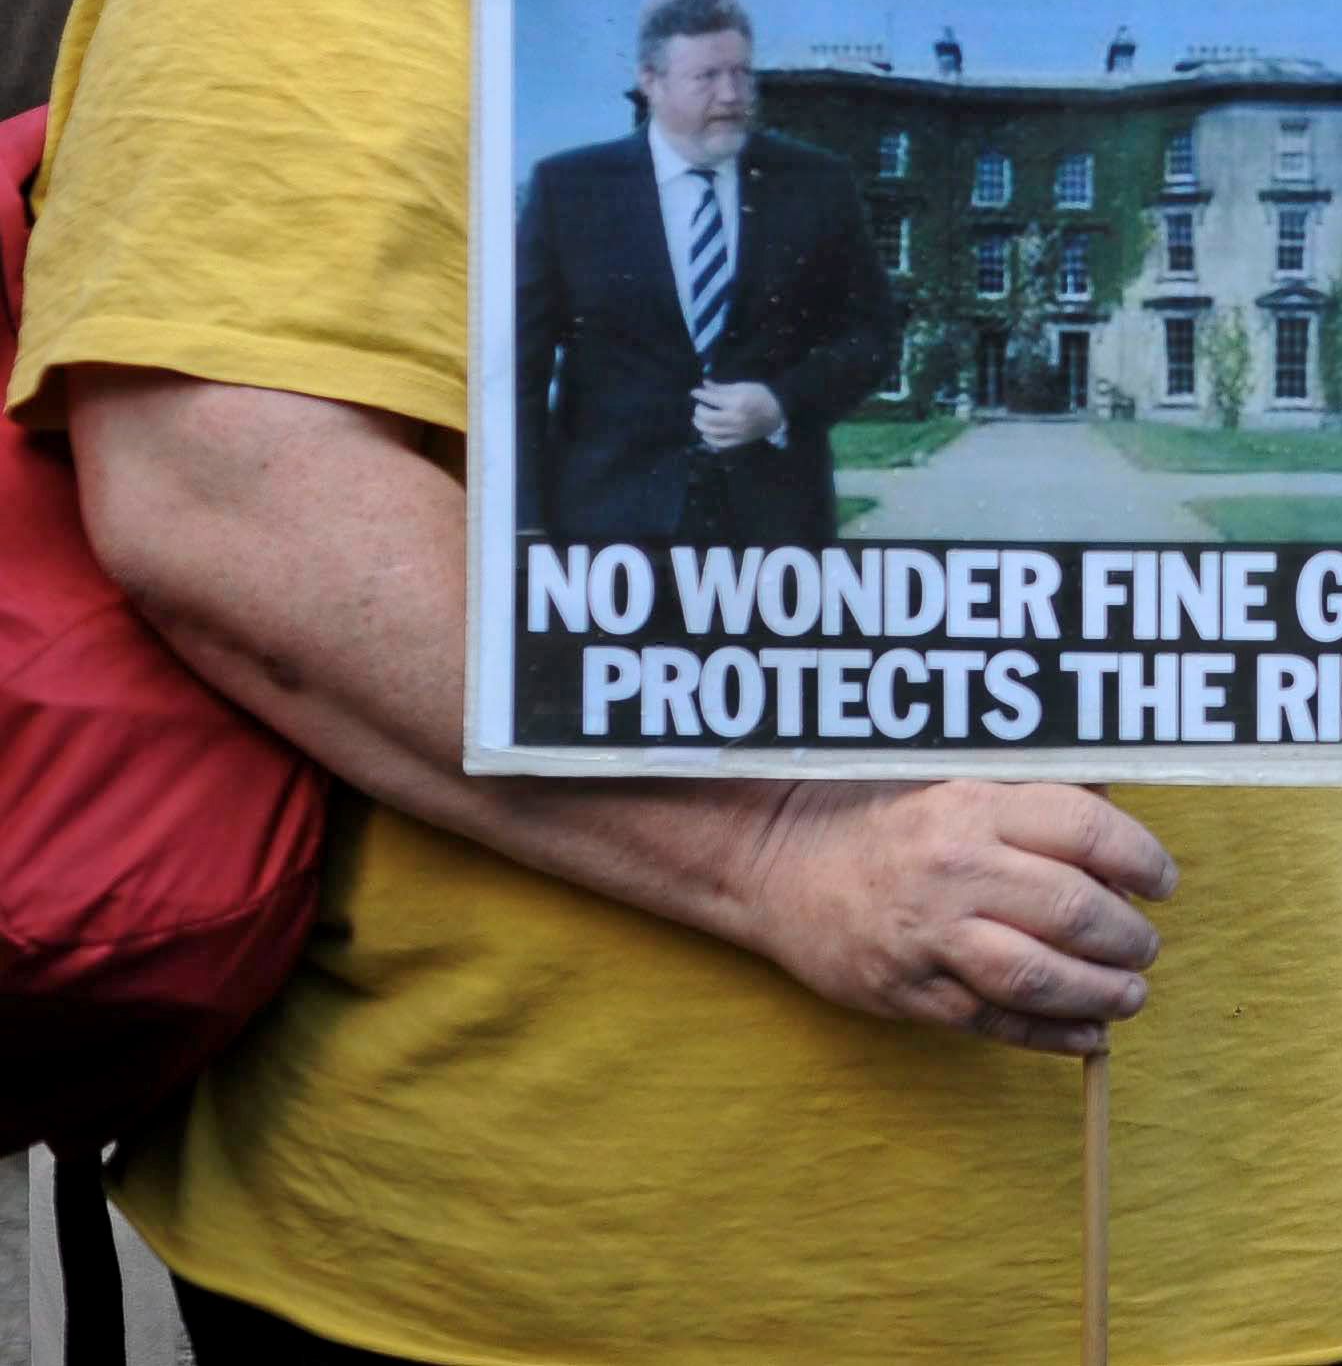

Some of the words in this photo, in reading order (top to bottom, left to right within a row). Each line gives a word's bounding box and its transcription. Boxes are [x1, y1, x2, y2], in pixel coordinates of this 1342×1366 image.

[527, 542, 655, 636] NO
[669, 544, 1062, 640] WONDER
[1081, 549, 1278, 642] FINE
[582, 643, 1043, 741] PROTECTS
[1059, 651, 1236, 742] THE
